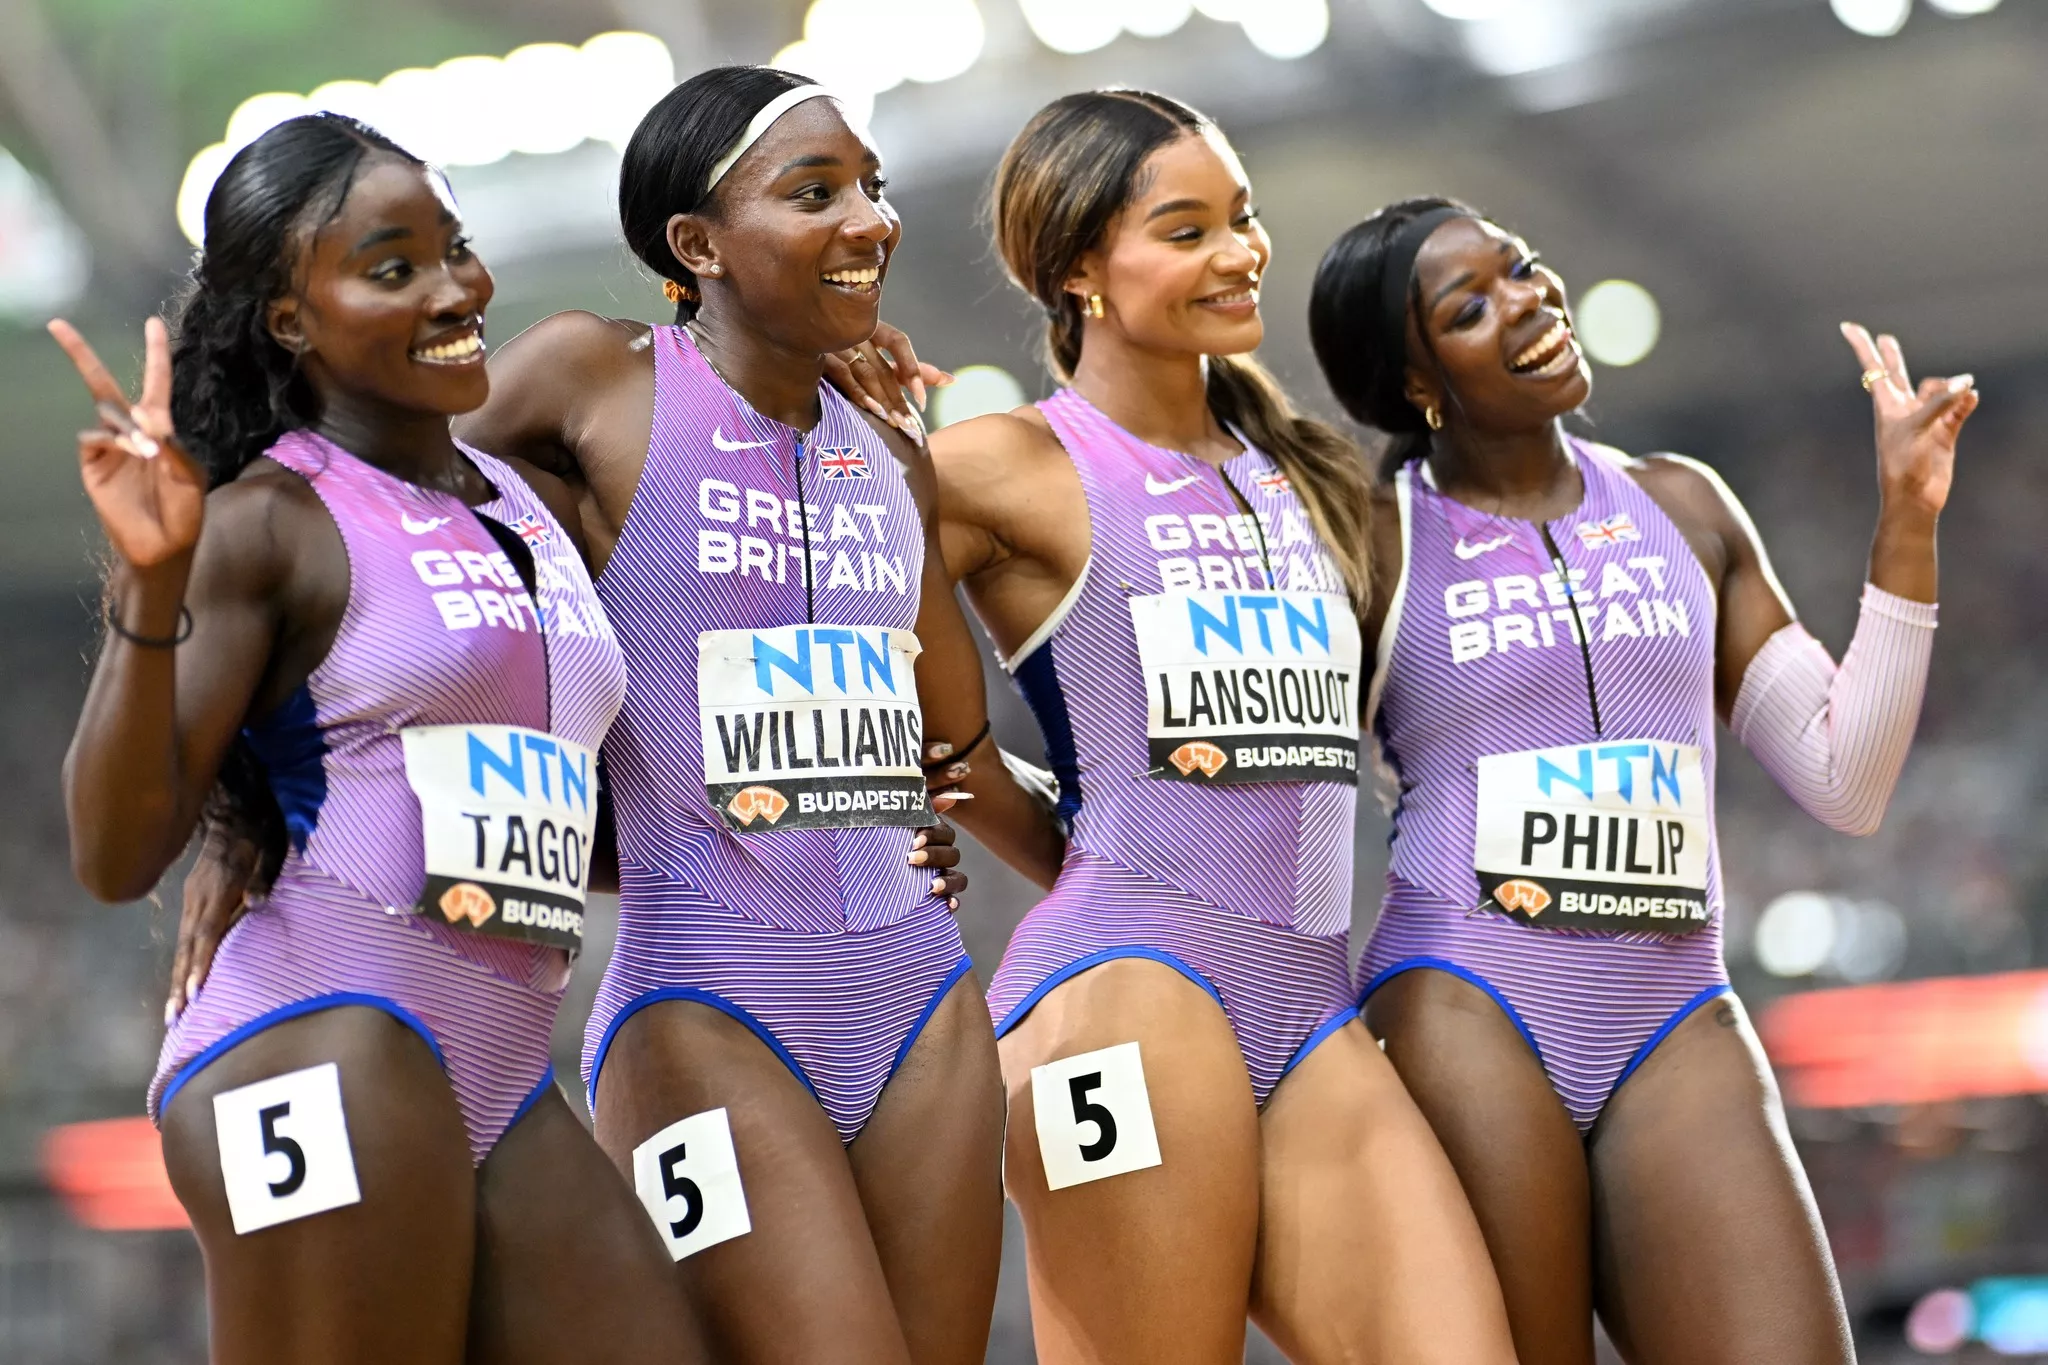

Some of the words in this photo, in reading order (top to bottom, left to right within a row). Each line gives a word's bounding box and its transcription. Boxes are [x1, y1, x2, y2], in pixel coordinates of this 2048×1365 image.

[699, 478, 888, 543] GREAT
[698, 530, 906, 595] BRITAIN
[1444, 556, 1667, 618] GREAT
[1186, 596, 1330, 657] NTN
[1450, 599, 1690, 664] BRITAIN
[752, 629, 897, 696] NTN
[1159, 668, 1350, 728] LANSIQUOT
[466, 729, 588, 815] NTN
[715, 708, 922, 774] WILLIAMS
[1536, 744, 1681, 808] NTN
[461, 809, 587, 889] TAGO
[1521, 811, 1684, 876] PHILIP
[502, 898, 583, 938] BUDAPE
[1069, 1071, 1117, 1162] 5
[259, 1101, 306, 1198] 5
[658, 1142, 704, 1239] 5
